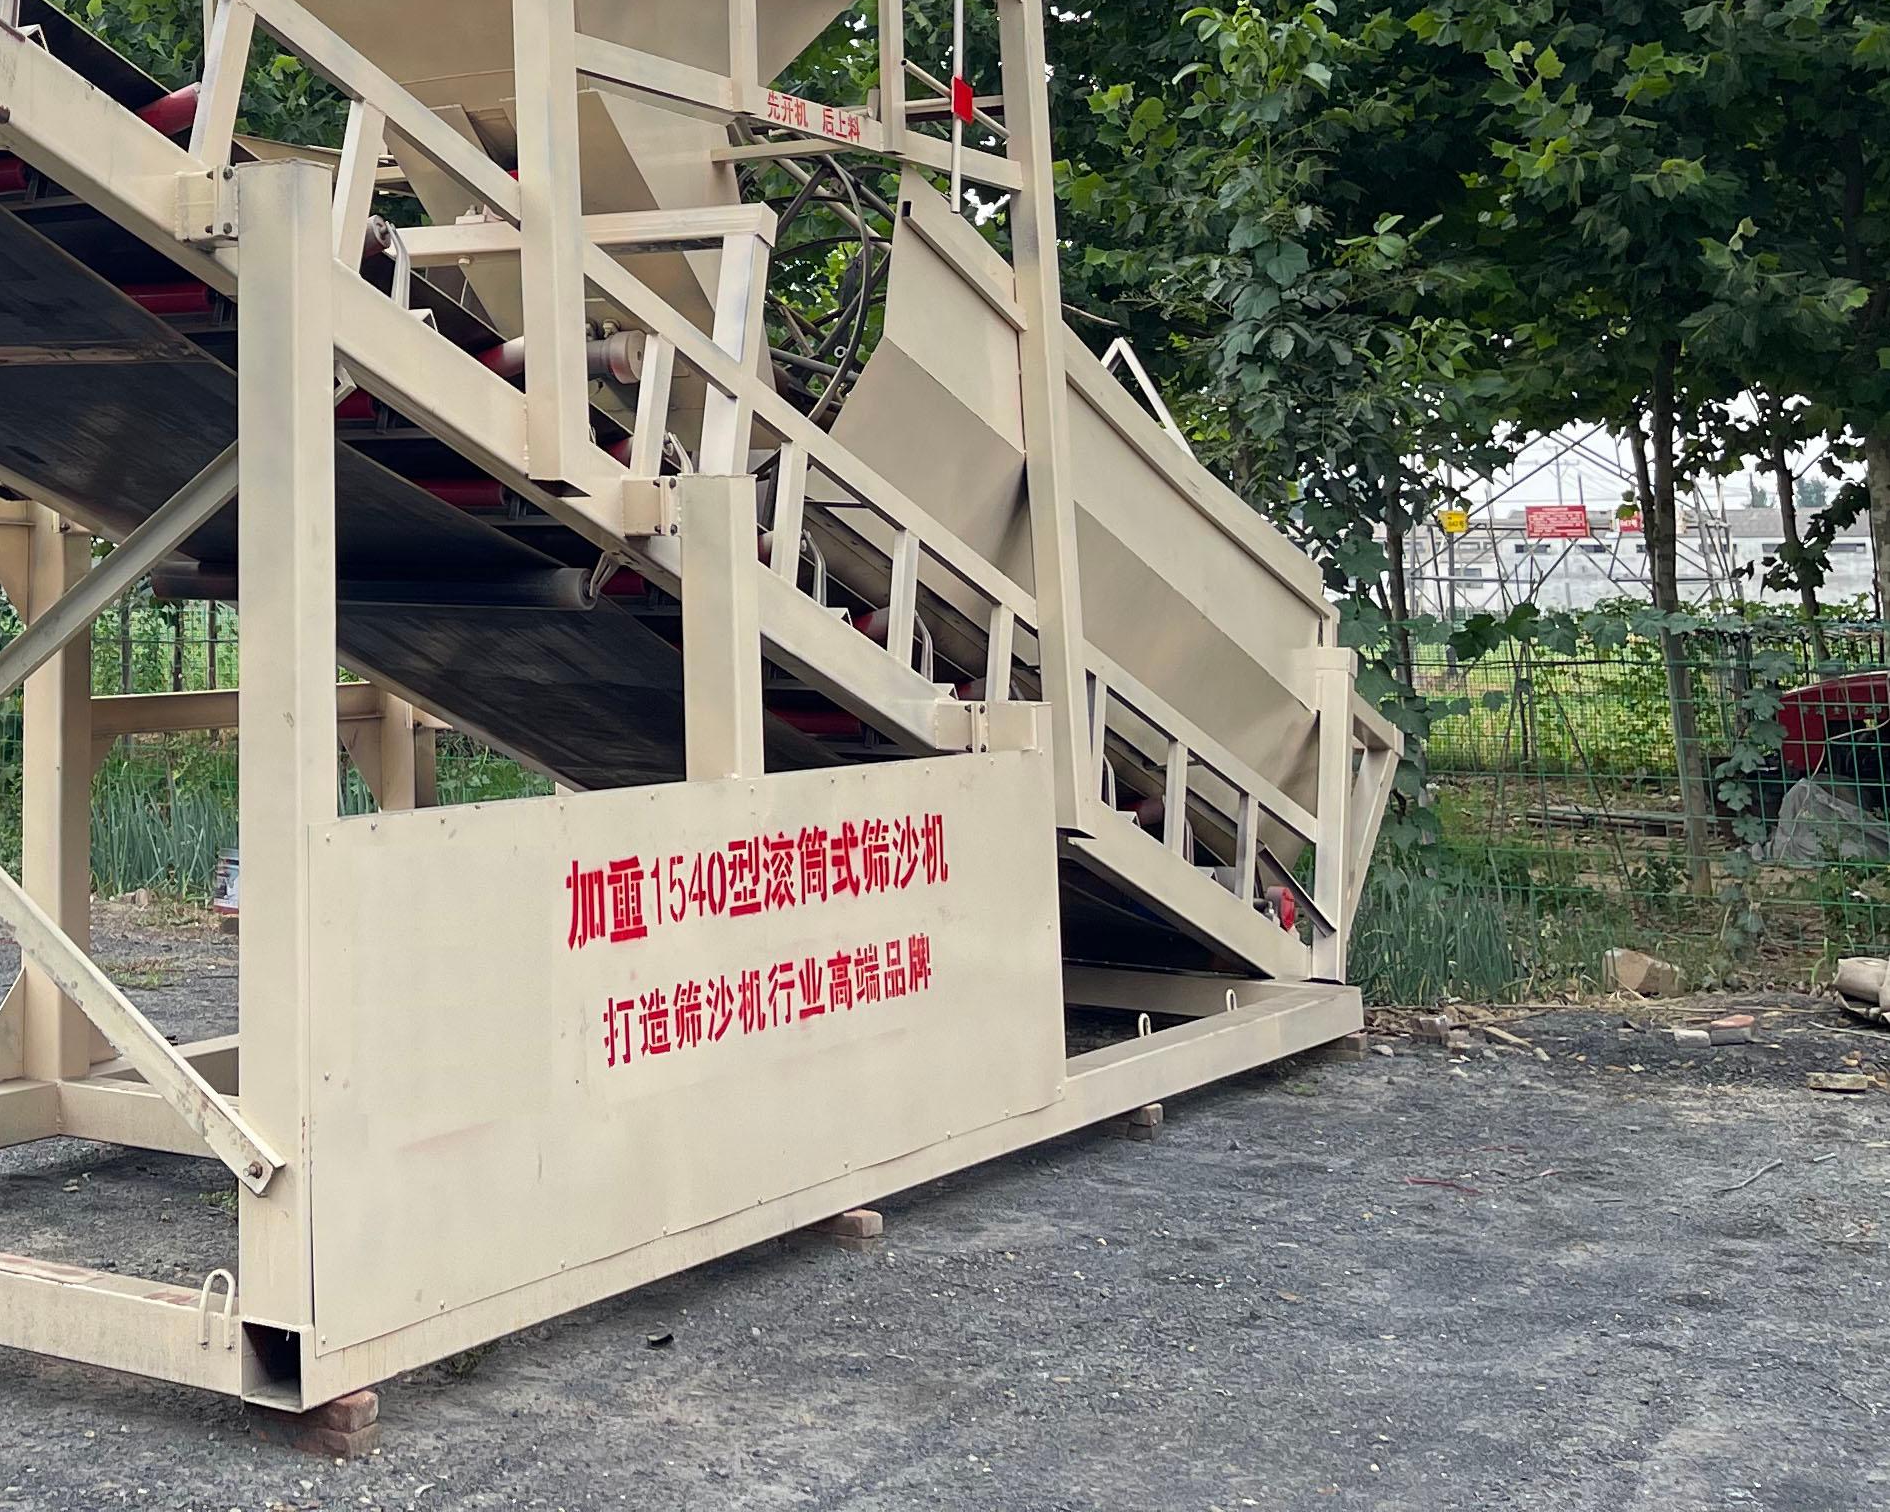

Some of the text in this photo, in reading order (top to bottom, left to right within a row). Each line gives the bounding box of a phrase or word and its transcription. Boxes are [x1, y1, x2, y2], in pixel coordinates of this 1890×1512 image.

[767, 91, 861, 143] 先开机 后上料
[565, 813, 949, 951] 加重1540型滚筒式筛沙机
[603, 932, 933, 1068] 打造筛沙机行业高端品牌
